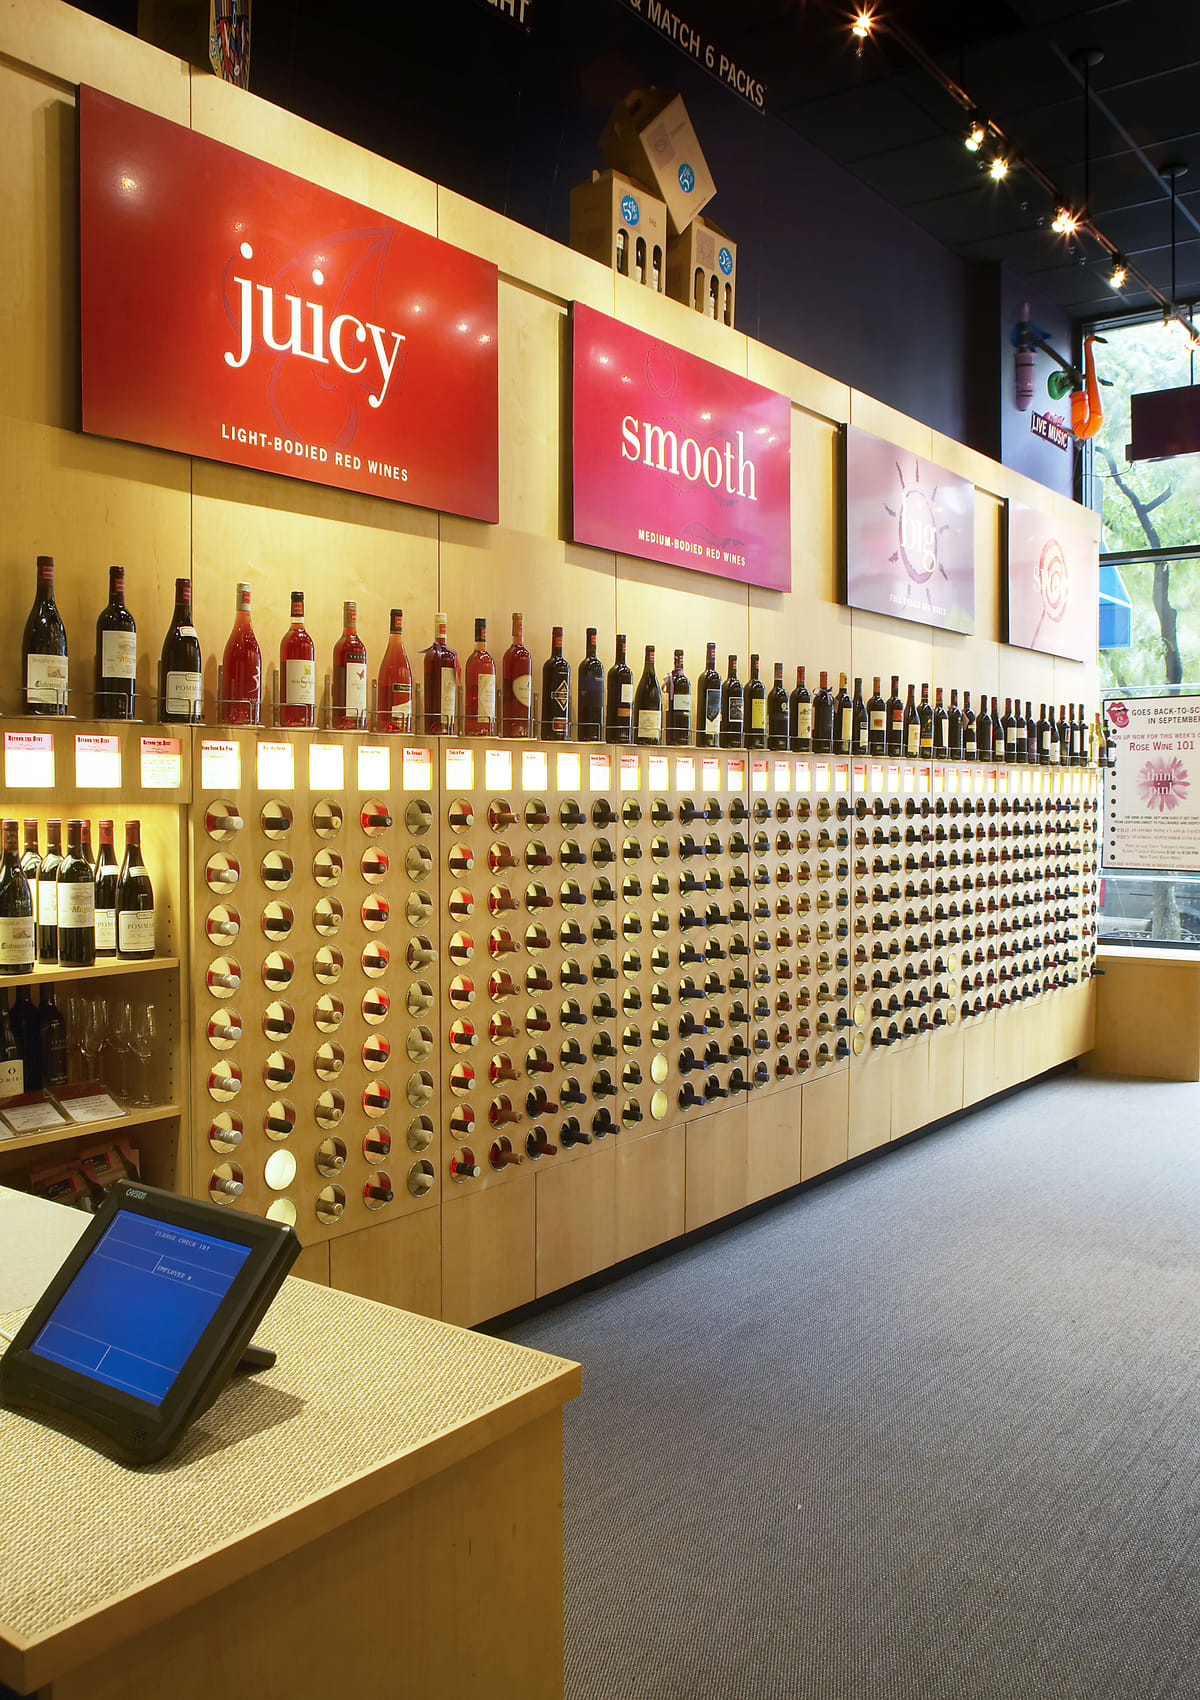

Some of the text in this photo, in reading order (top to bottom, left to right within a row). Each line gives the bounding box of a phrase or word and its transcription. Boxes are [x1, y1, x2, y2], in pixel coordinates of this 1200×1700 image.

[648, 0, 764, 107] MATCH 6 PACKS
[224, 241, 406, 408] juicy
[222, 423, 408, 482] LIGHT-BODIED RED WINES
[1032, 414, 1068, 448] LIVE MUSIC
[622, 415, 758, 501] smooth
[638, 529, 746, 567] MEDIUM-BODIED RED WINES
[1131, 708, 1151, 716] GOES
[1153, 741, 1173, 751] WINE
[1177, 740, 1194, 750] 101
